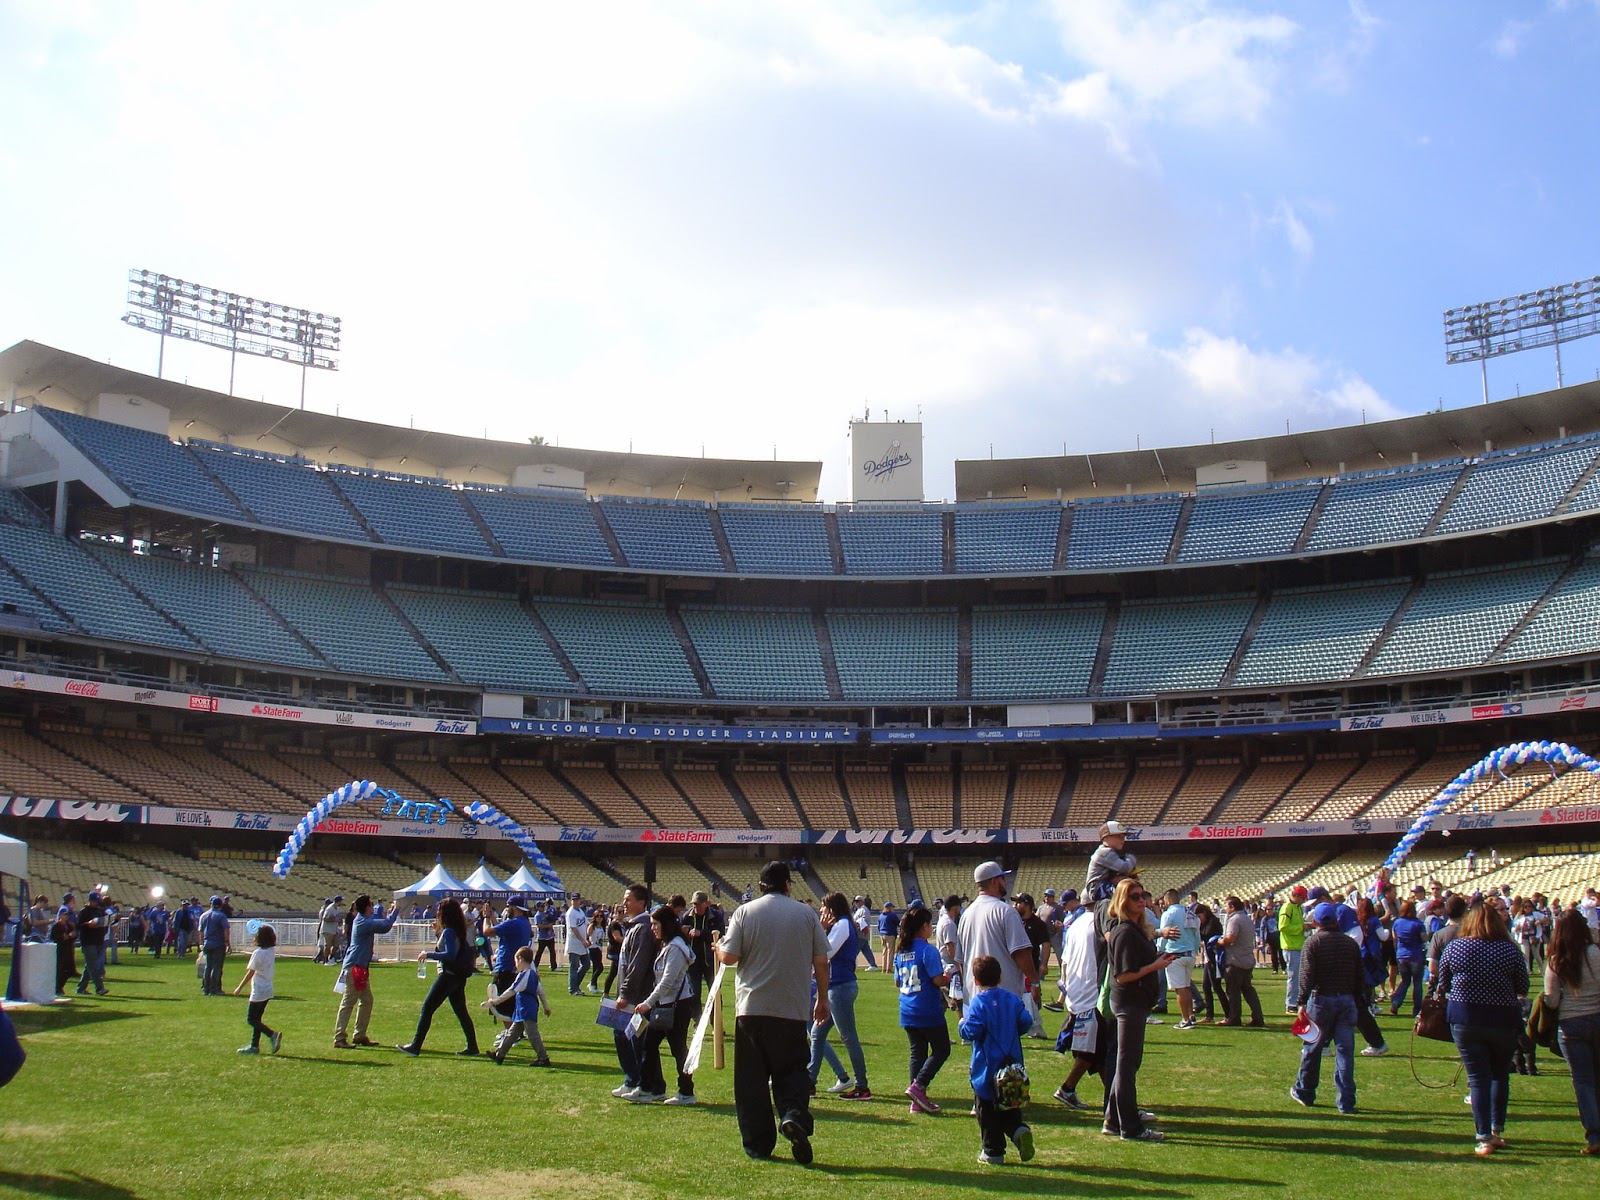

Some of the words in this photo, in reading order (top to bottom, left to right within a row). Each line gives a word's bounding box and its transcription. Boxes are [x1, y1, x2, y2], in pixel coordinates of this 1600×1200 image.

[863, 453, 912, 477] Dodgers
[1410, 714, 1420, 723] WE
[1421, 713, 1437, 722] LOVE
[510, 721, 600, 734] WELCOME
[617, 727, 637, 735] TO
[654, 728, 730, 738] DODGER
[747, 730, 833, 739] STADIUM
[175, 811, 187, 822] WE
[188, 812, 203, 824] LOVE
[1395, 820, 1406, 830] WE
[1041, 831, 1053, 840] WE
[1053, 831, 1068, 840] LOVE
[899, 965, 921, 995] 24
